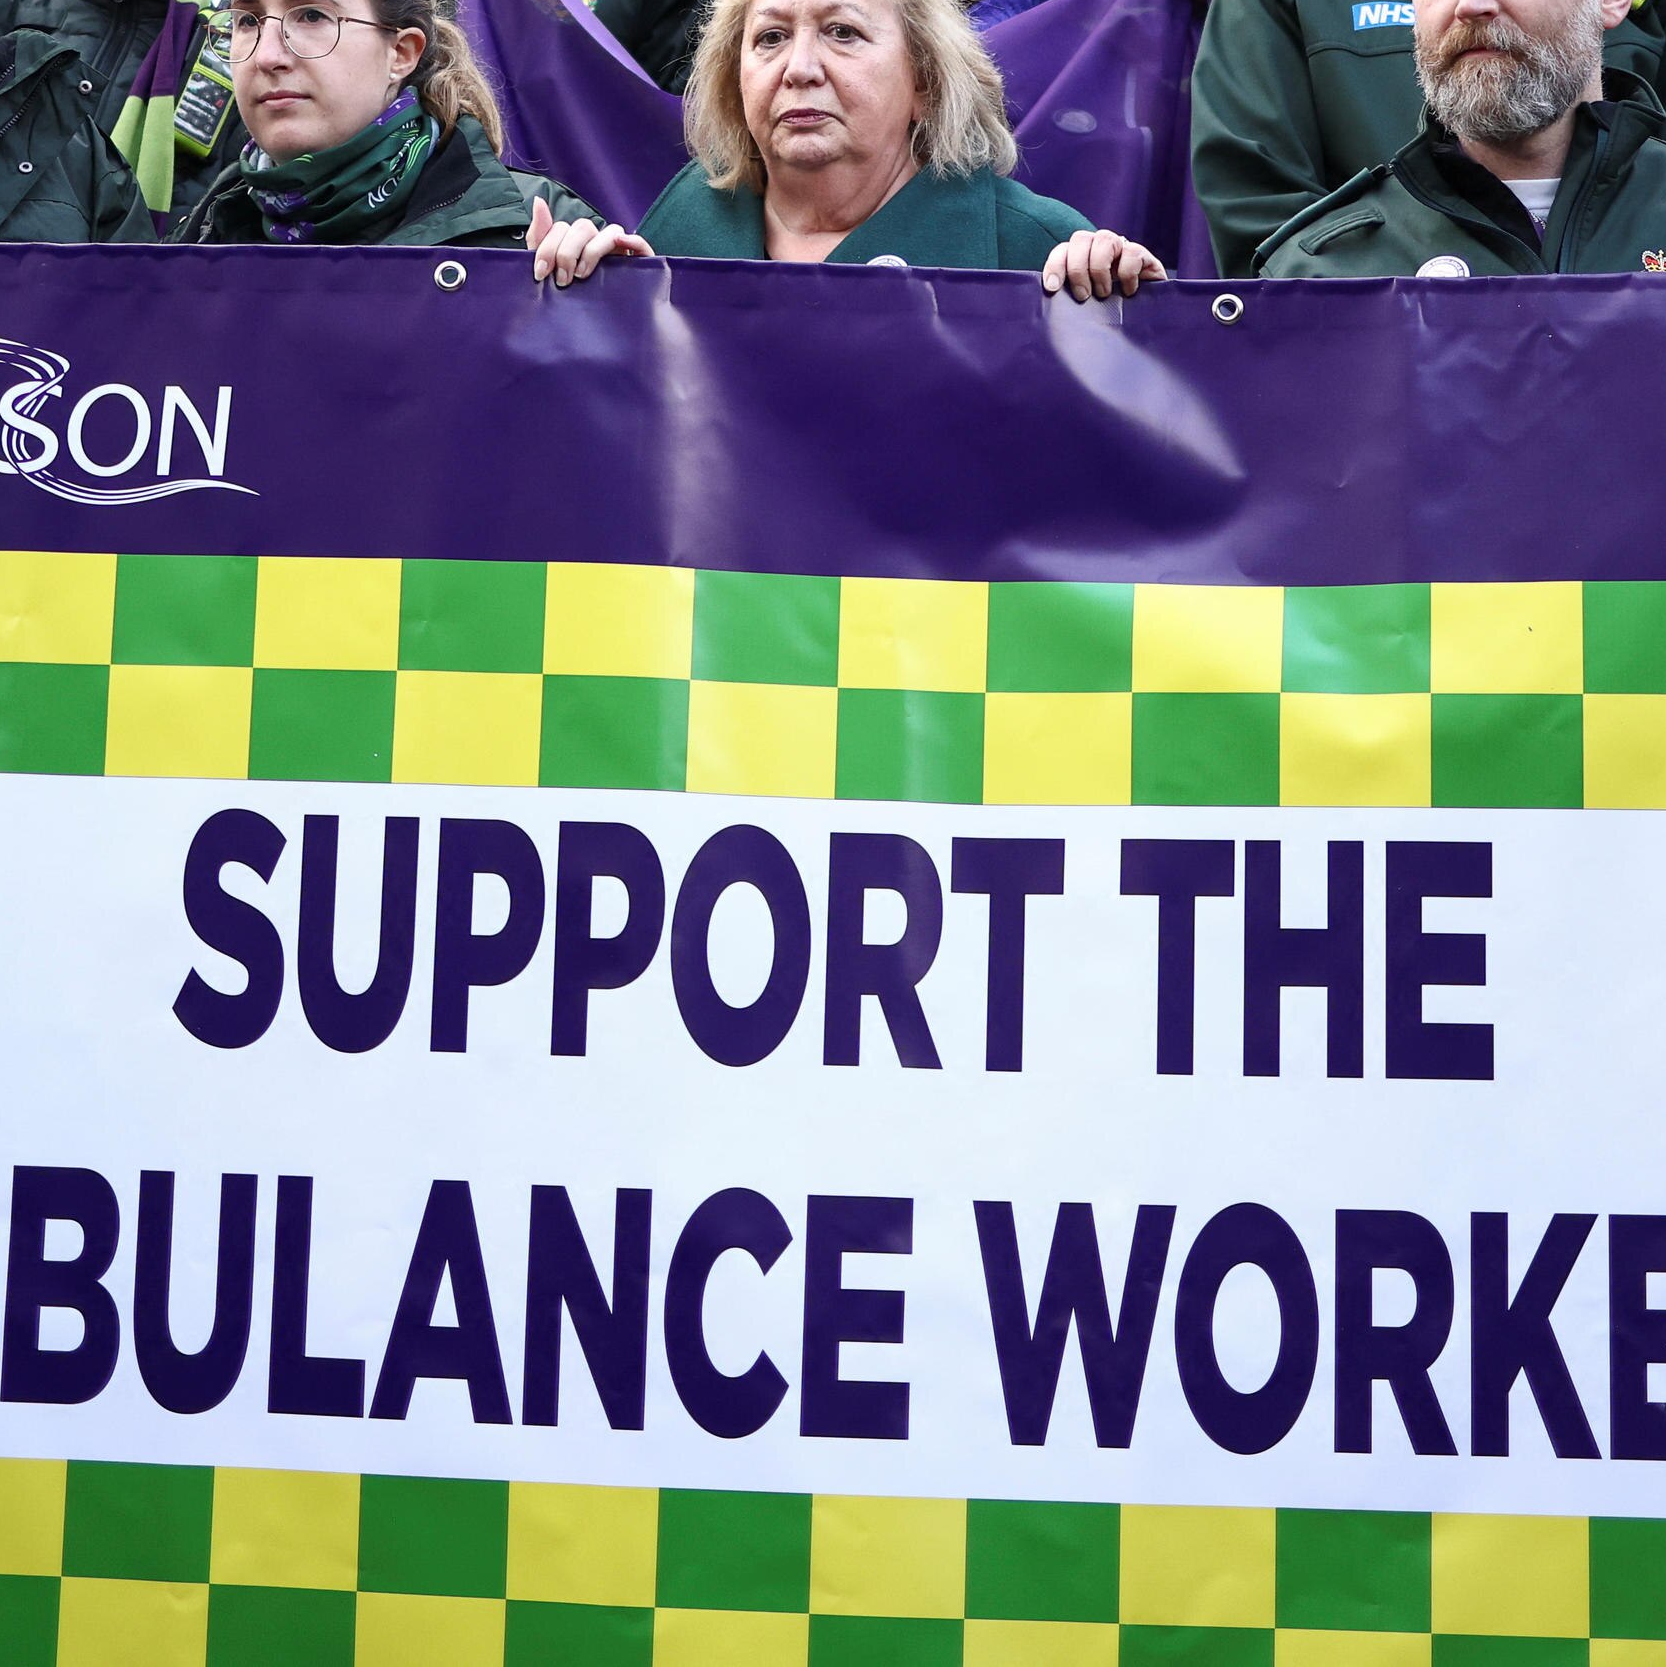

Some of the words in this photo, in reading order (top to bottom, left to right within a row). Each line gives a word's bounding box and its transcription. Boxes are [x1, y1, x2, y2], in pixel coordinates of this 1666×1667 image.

[1358, 3, 1417, 27] NHS
[171, 808, 1066, 1073] SUPPORT
[1119, 838, 1495, 1081] THE
